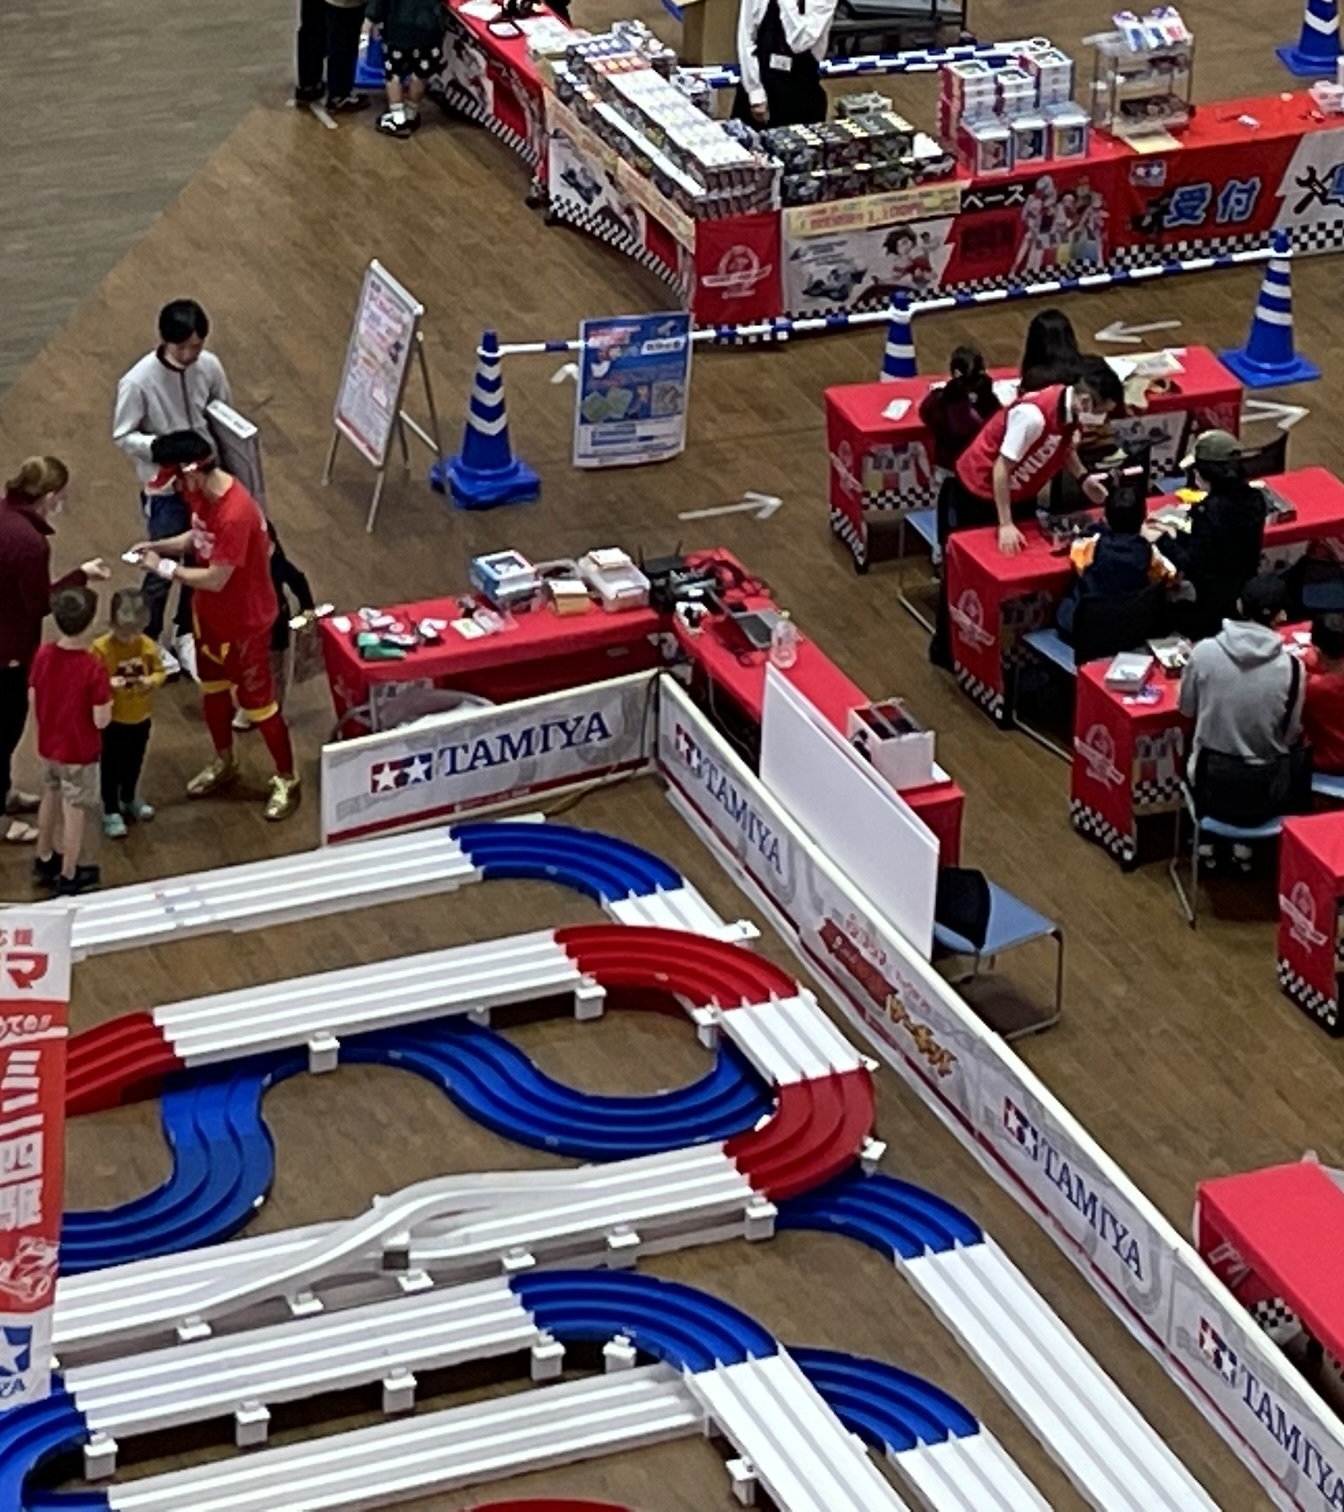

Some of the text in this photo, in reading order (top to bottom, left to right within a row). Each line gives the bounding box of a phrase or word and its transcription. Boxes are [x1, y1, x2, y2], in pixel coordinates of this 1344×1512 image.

[1163, 175, 1262, 228] 受付
[438, 711, 613, 778] TAMIYA
[703, 757, 783, 875] TAMIYA
[1036, 1138, 1144, 1282] TAMIYA
